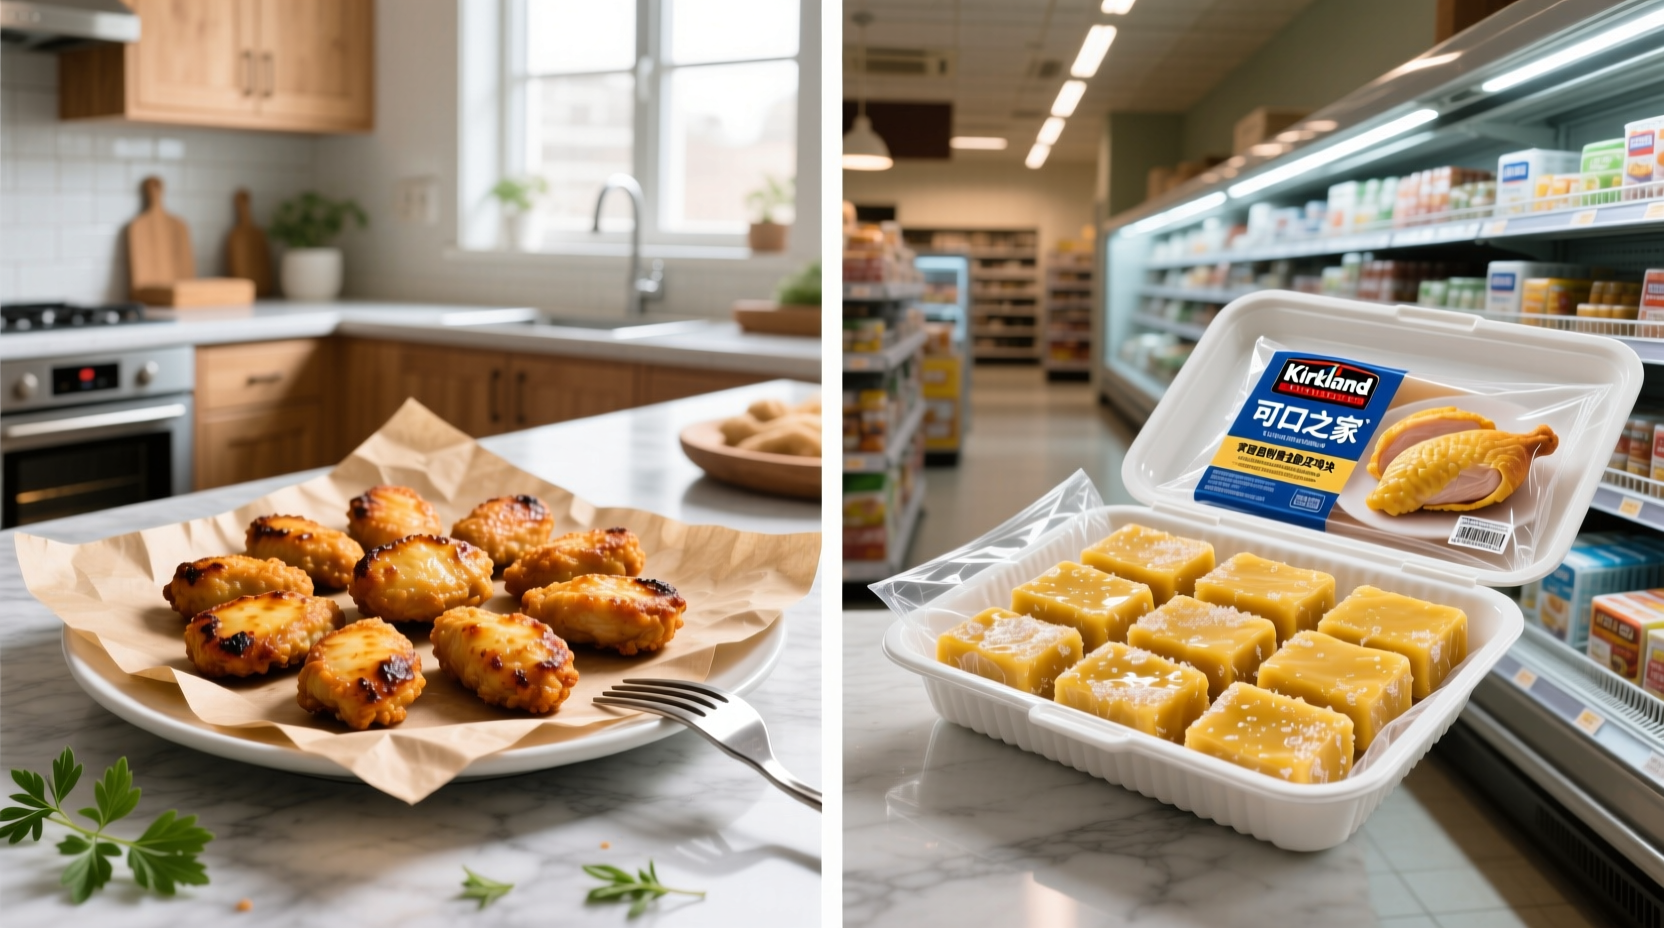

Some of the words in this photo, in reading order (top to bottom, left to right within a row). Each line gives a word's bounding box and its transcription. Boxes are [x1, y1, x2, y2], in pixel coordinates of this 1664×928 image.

[1283, 363, 1373, 396] Kirkland
[1253, 399, 1364, 444] 可口之家
